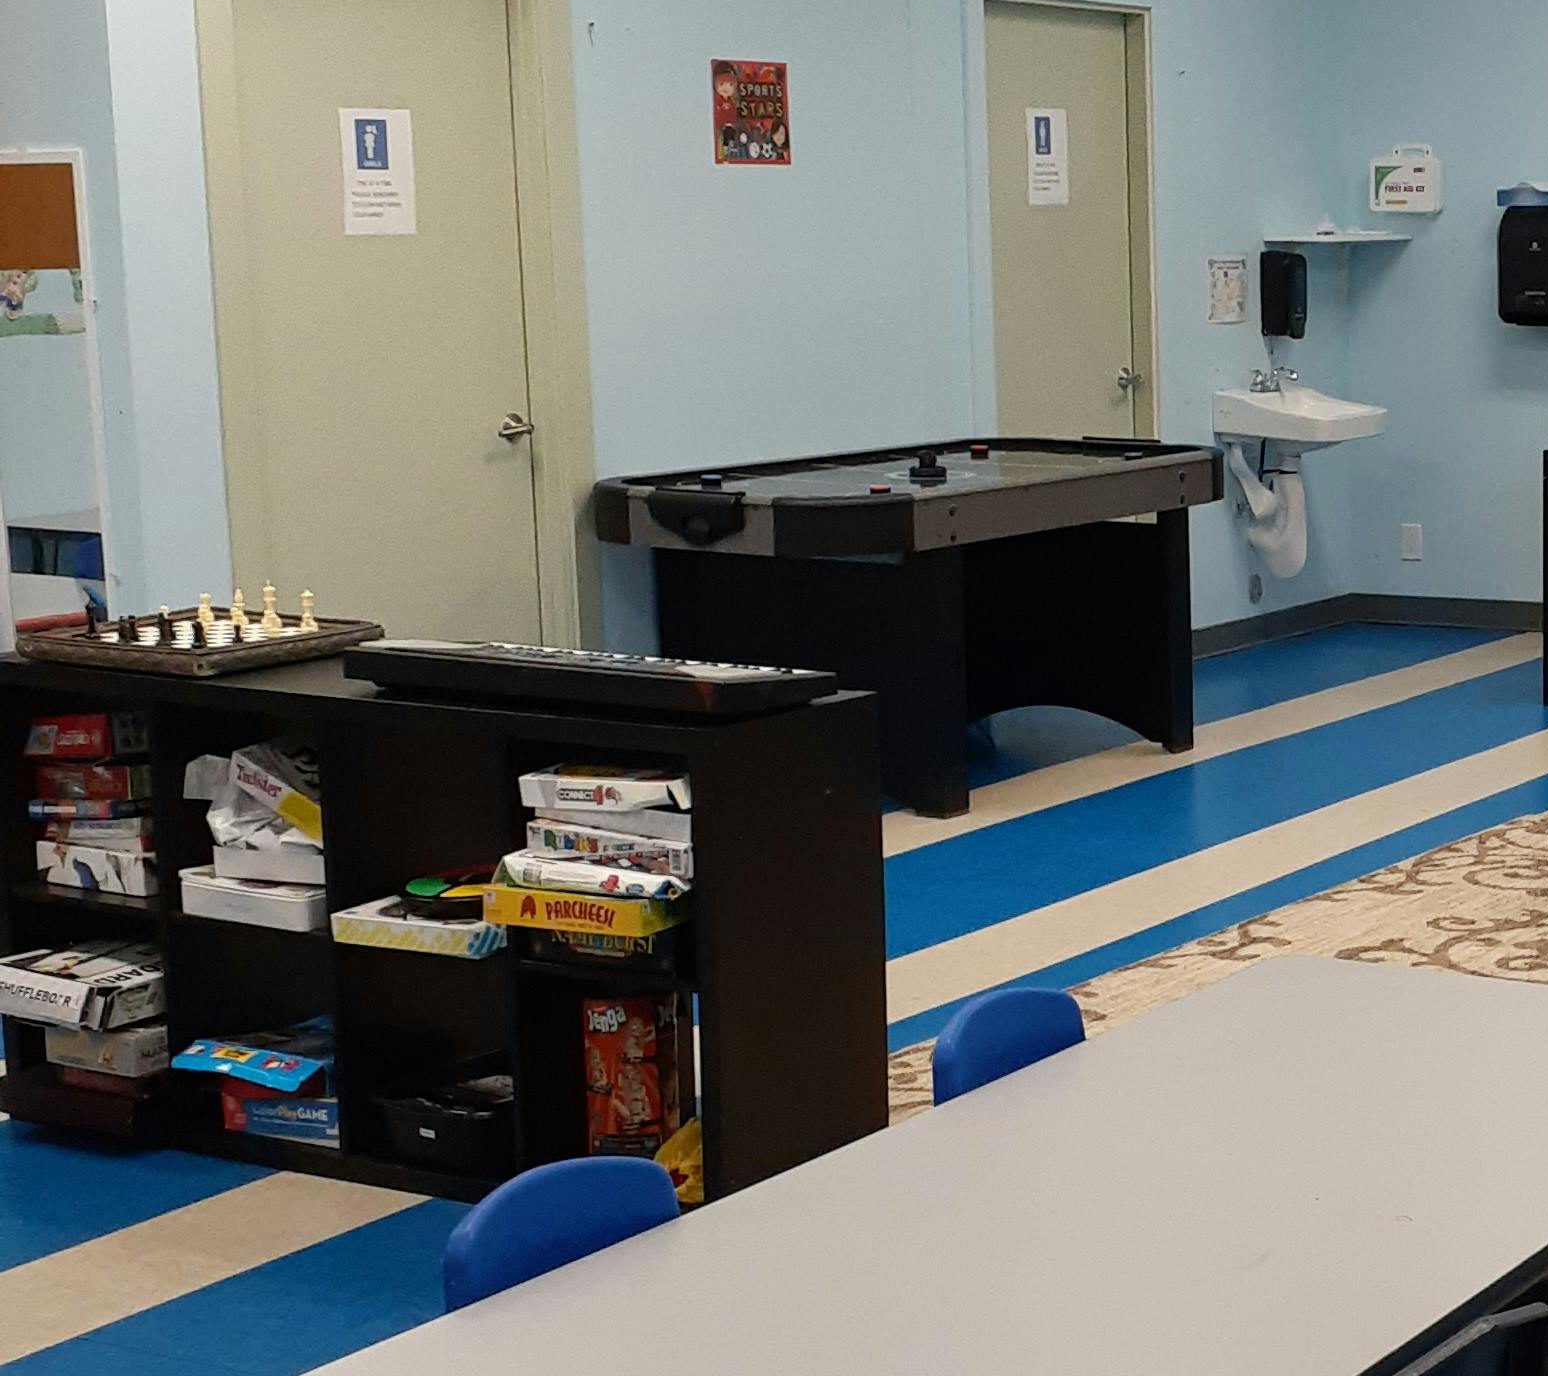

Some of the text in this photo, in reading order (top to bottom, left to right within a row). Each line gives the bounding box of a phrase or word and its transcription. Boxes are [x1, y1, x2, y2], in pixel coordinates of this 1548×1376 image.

[739, 82, 783, 98] SPORTS
[739, 101, 785, 118] STARS
[1384, 185, 1401, 193] FIRST
[558, 787, 594, 802] CONNECT
[545, 899, 617, 928] PARCHEESI
[587, 1005, 627, 1033] Jenga
[296, 1106, 329, 1122] GAME
